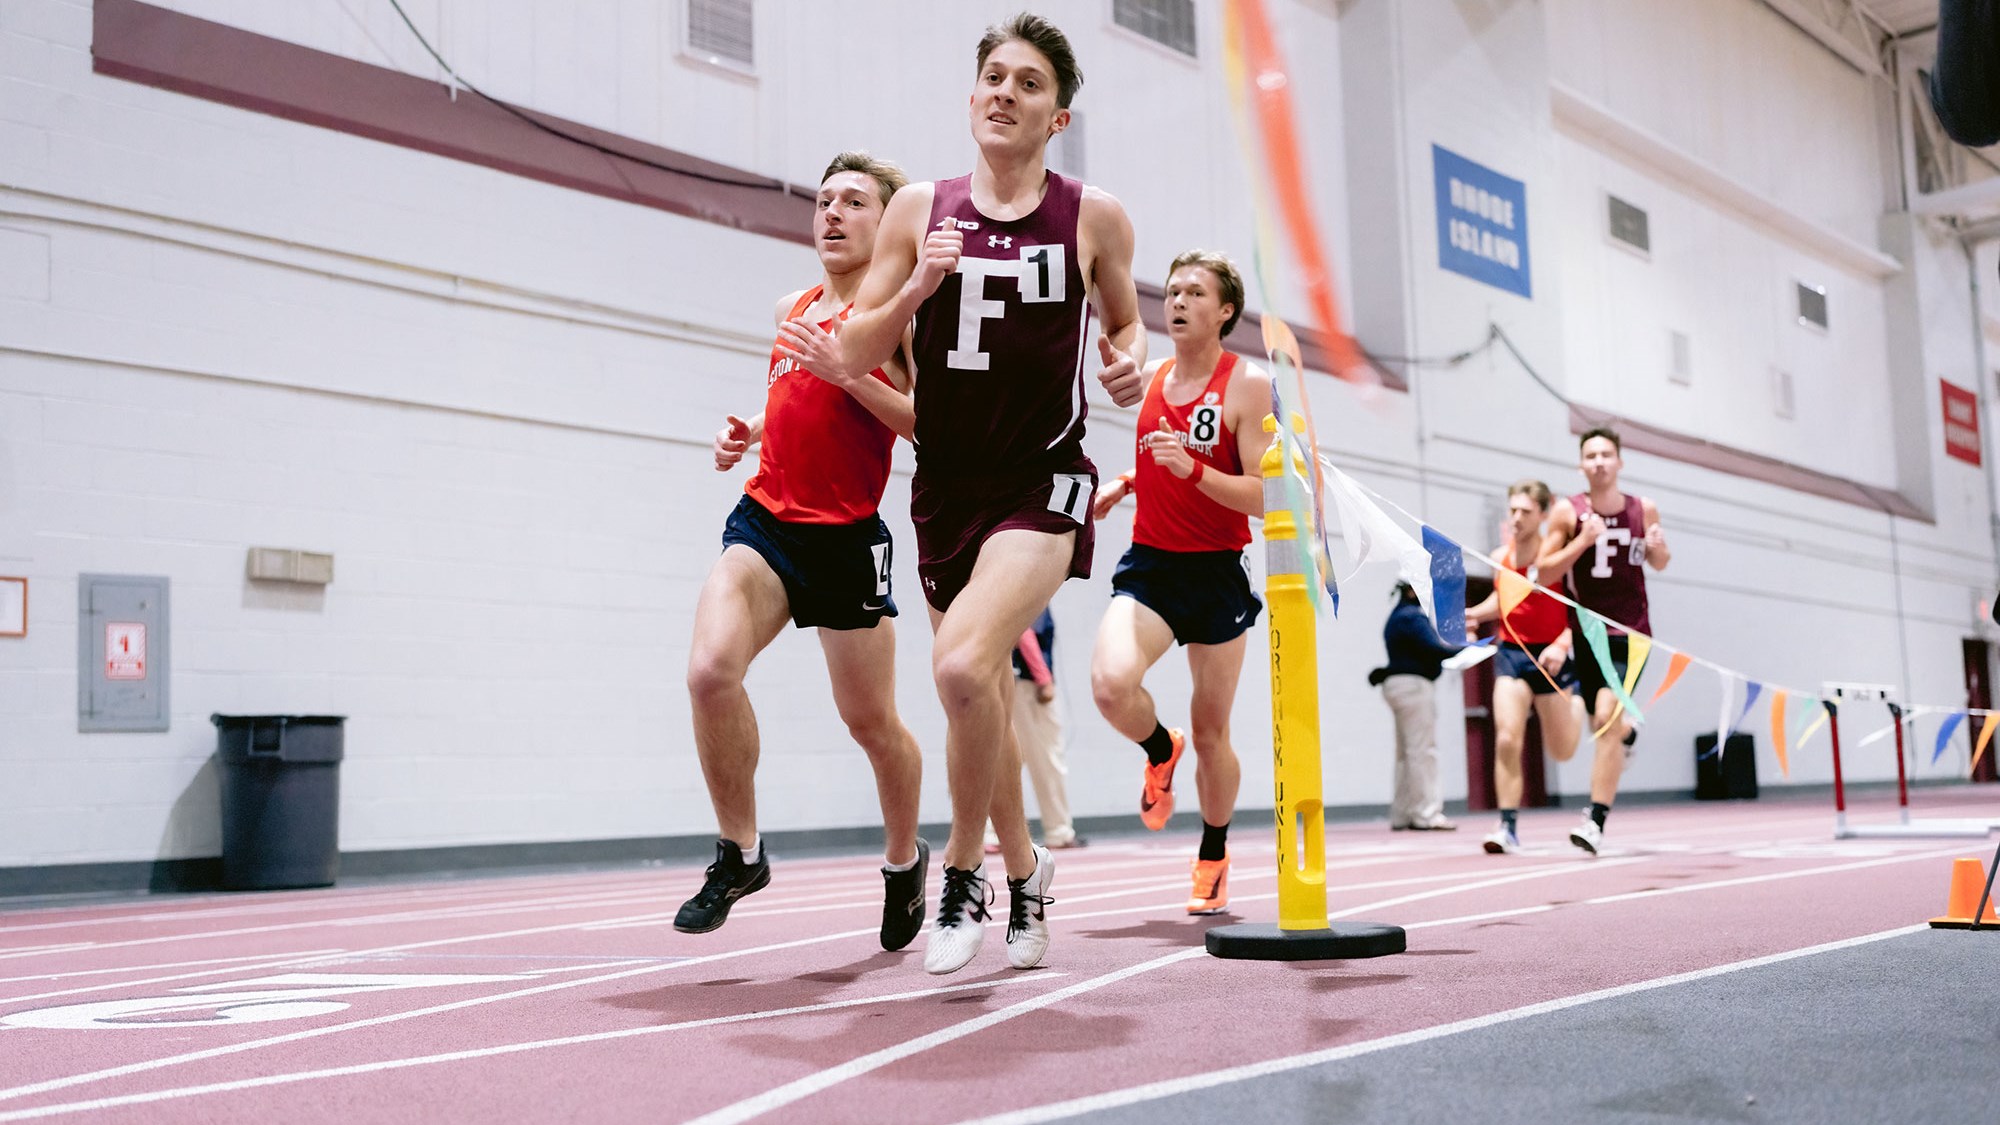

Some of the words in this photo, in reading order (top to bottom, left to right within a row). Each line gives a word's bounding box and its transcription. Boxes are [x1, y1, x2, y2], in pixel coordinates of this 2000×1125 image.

[1450, 218, 1520, 270] ISLAND
[1028, 249, 1049, 298] 1
[947, 256, 1021, 371] F
[1194, 408, 1215, 441] 8
[1063, 477, 1081, 515] 1
[1591, 528, 1631, 578] F
